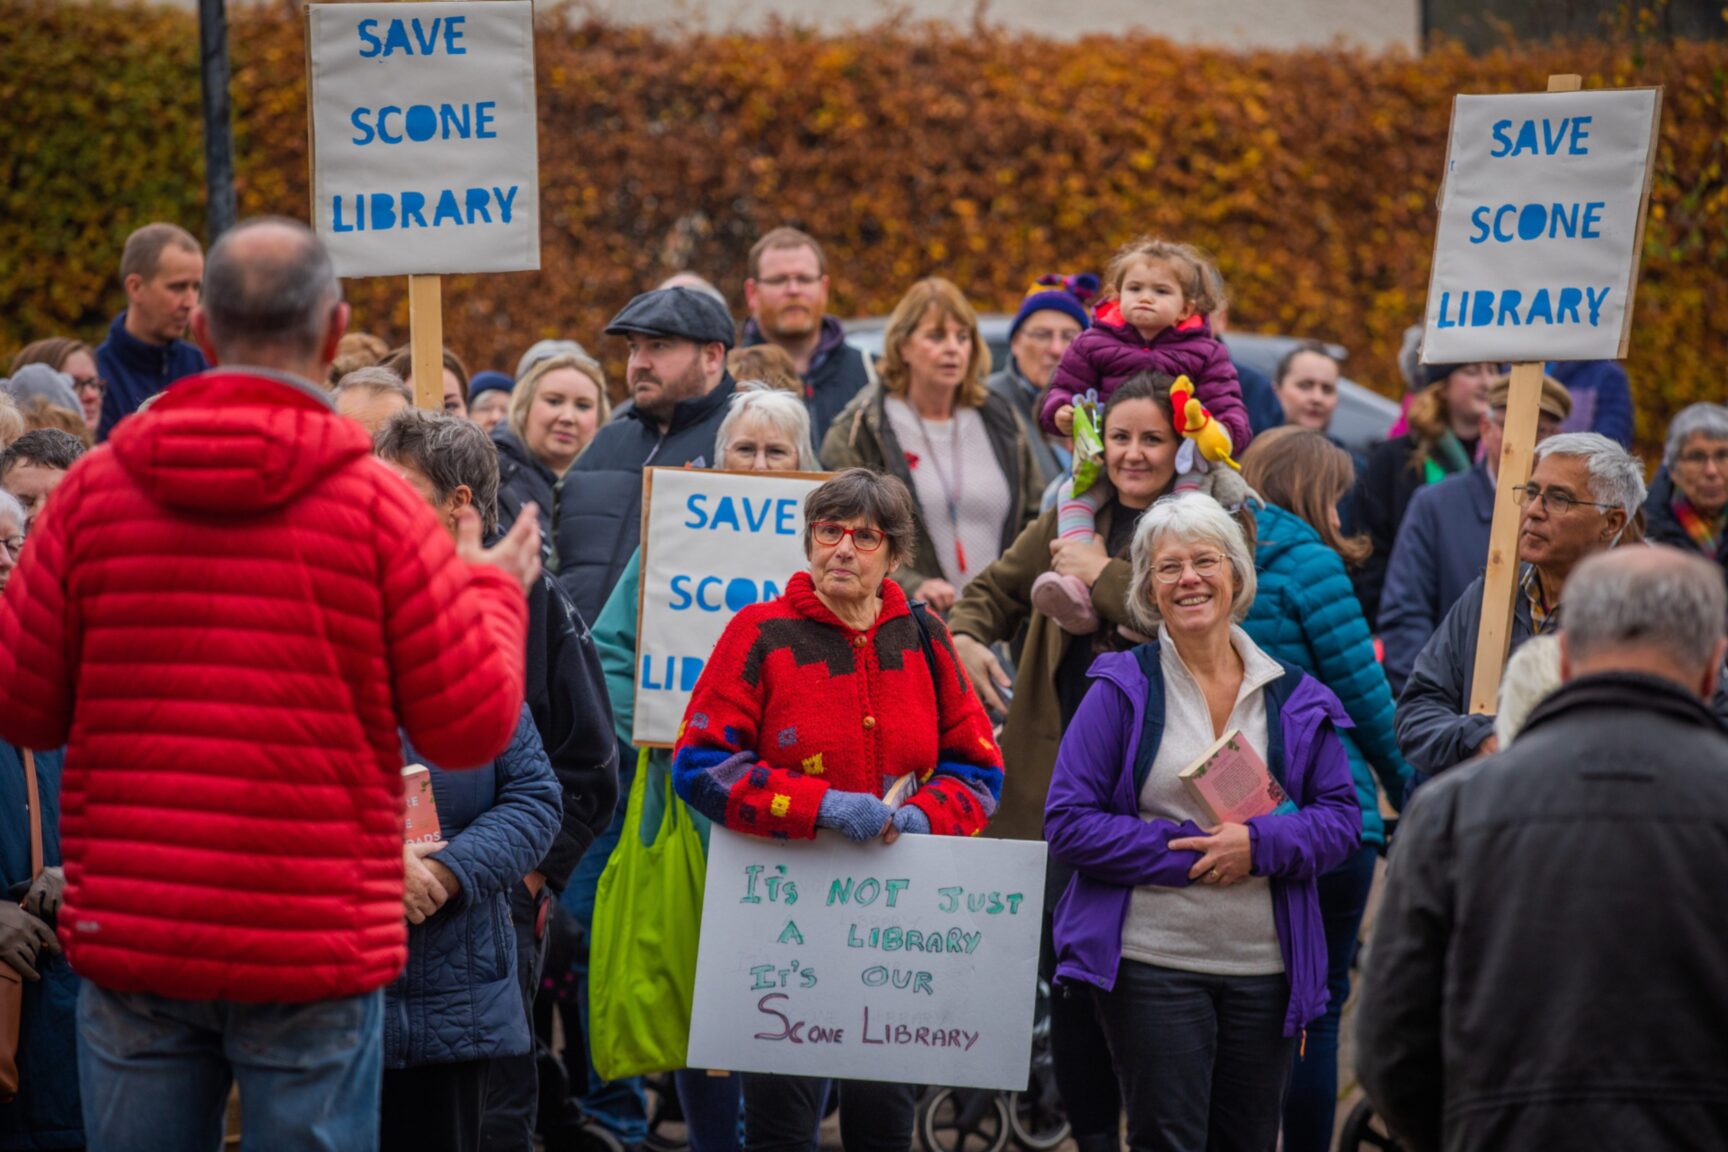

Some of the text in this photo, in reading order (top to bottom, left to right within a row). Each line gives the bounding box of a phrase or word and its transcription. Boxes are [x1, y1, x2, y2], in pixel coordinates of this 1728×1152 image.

[358, 16, 467, 58] SAVE
[351, 102, 497, 146] SCONE
[1490, 116, 1593, 158] SAVE
[333, 186, 519, 233] LIBRARY
[1469, 202, 1605, 244] SCONE
[1437, 287, 1611, 329] LIBRARY
[684, 493, 798, 535] SAVE
[826, 877, 910, 908] NOT
[937, 886, 1025, 915] JUST
[777, 920, 982, 955] A LIBRARY
[861, 965, 934, 996] OUR
[862, 1005, 980, 1052] LIBRARY
